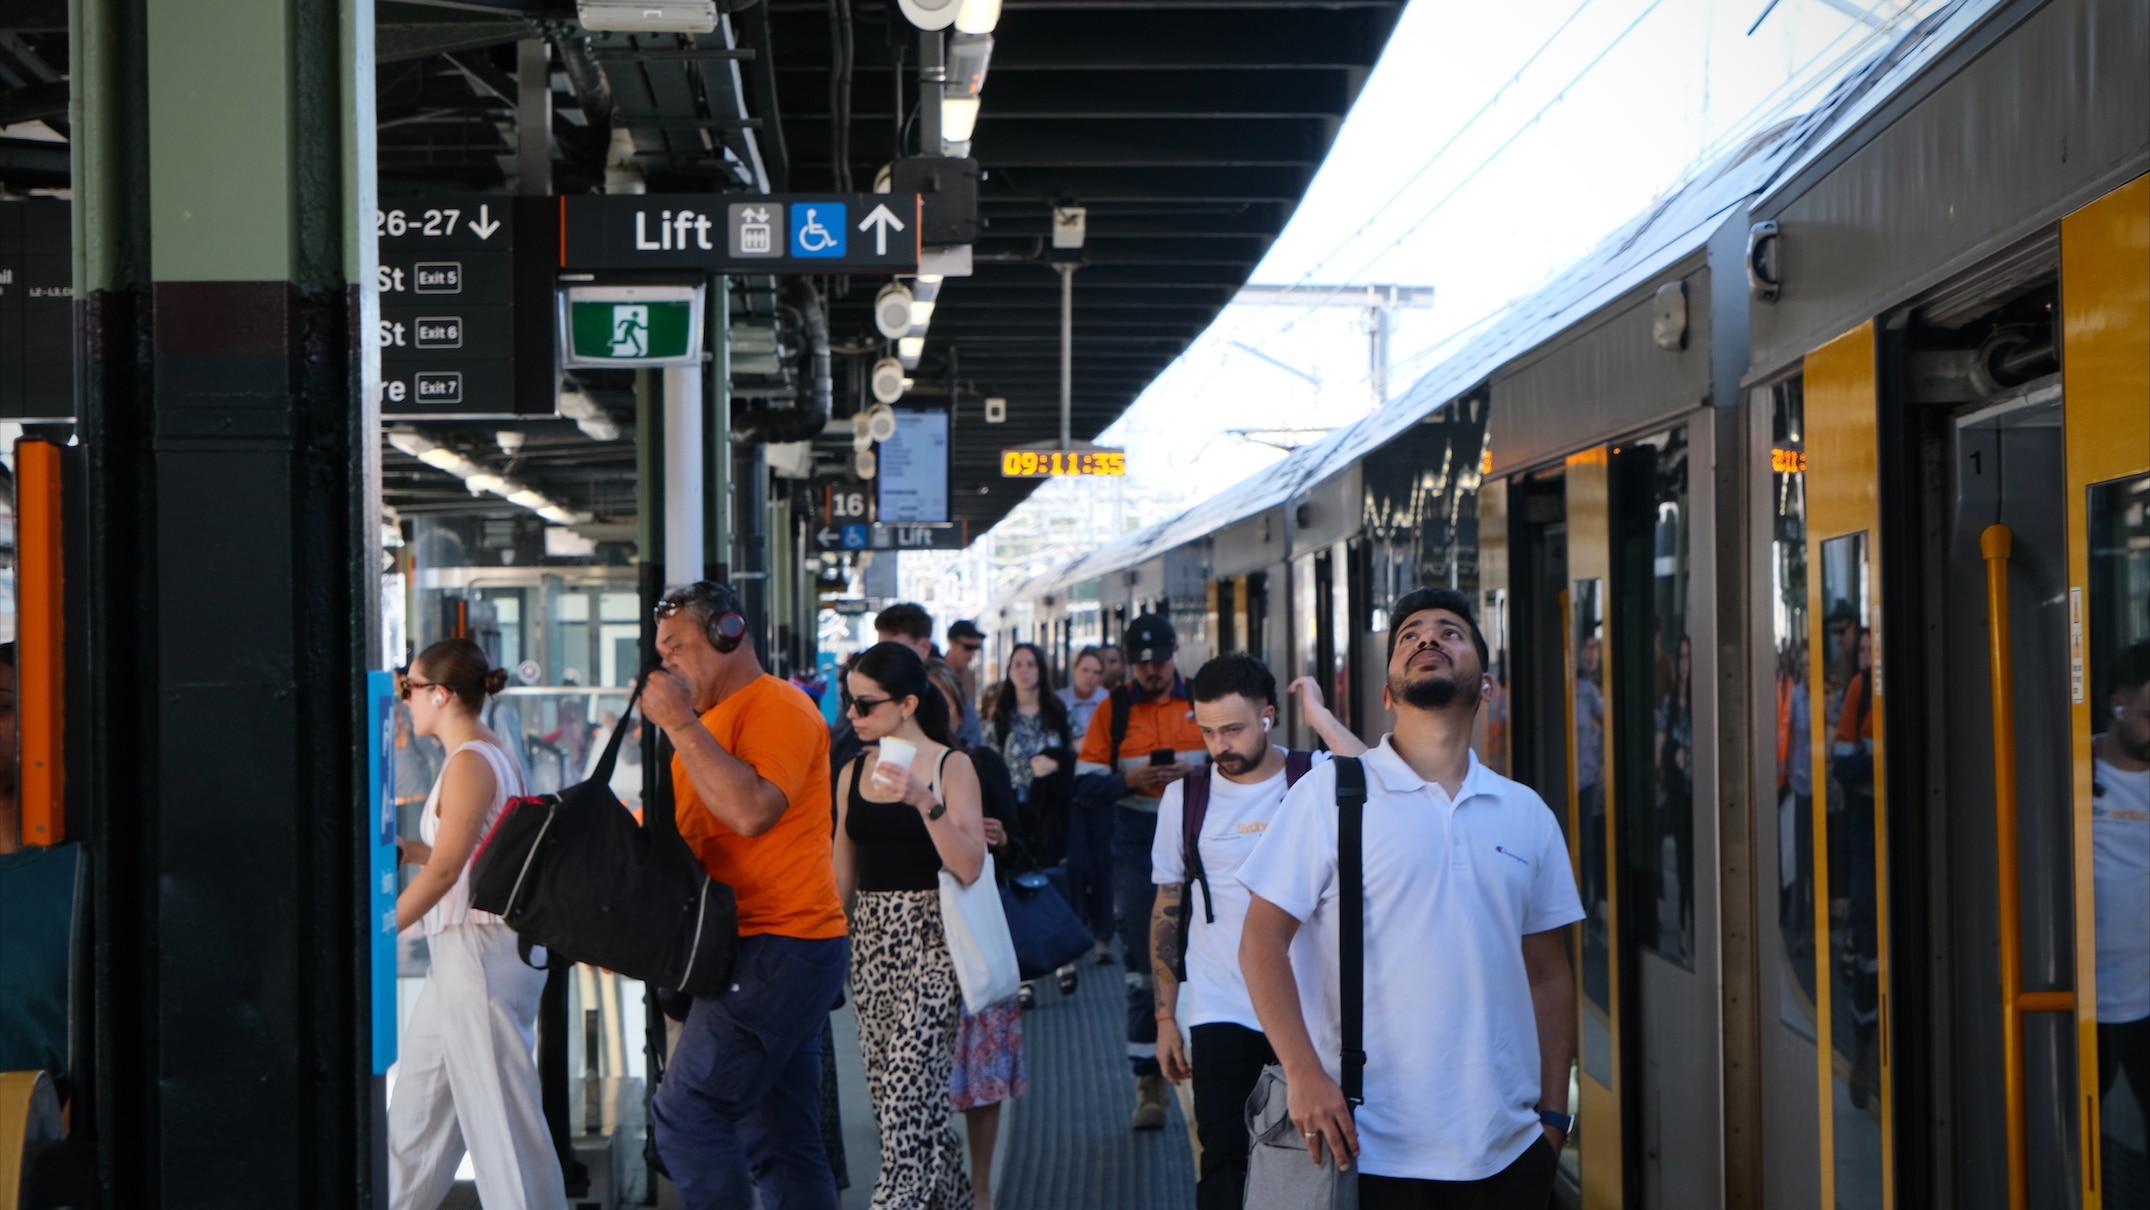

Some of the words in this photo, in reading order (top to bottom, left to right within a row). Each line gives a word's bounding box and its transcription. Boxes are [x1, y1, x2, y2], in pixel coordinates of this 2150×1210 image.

[636, 209, 713, 250] Lift
[378, 264, 405, 292] St
[419, 270, 445, 285] Exit
[447, 270, 457, 284] 5
[380, 320, 407, 347] St
[419, 325, 446, 340] Exit
[447, 325, 458, 339] 6
[419, 380, 446, 395] Exit
[447, 380, 458, 394] 7
[1003, 451, 1126, 476] 09:11:35
[1969, 450, 1981, 475] 1
[833, 492, 864, 516] 16
[898, 527, 933, 546] Lift
